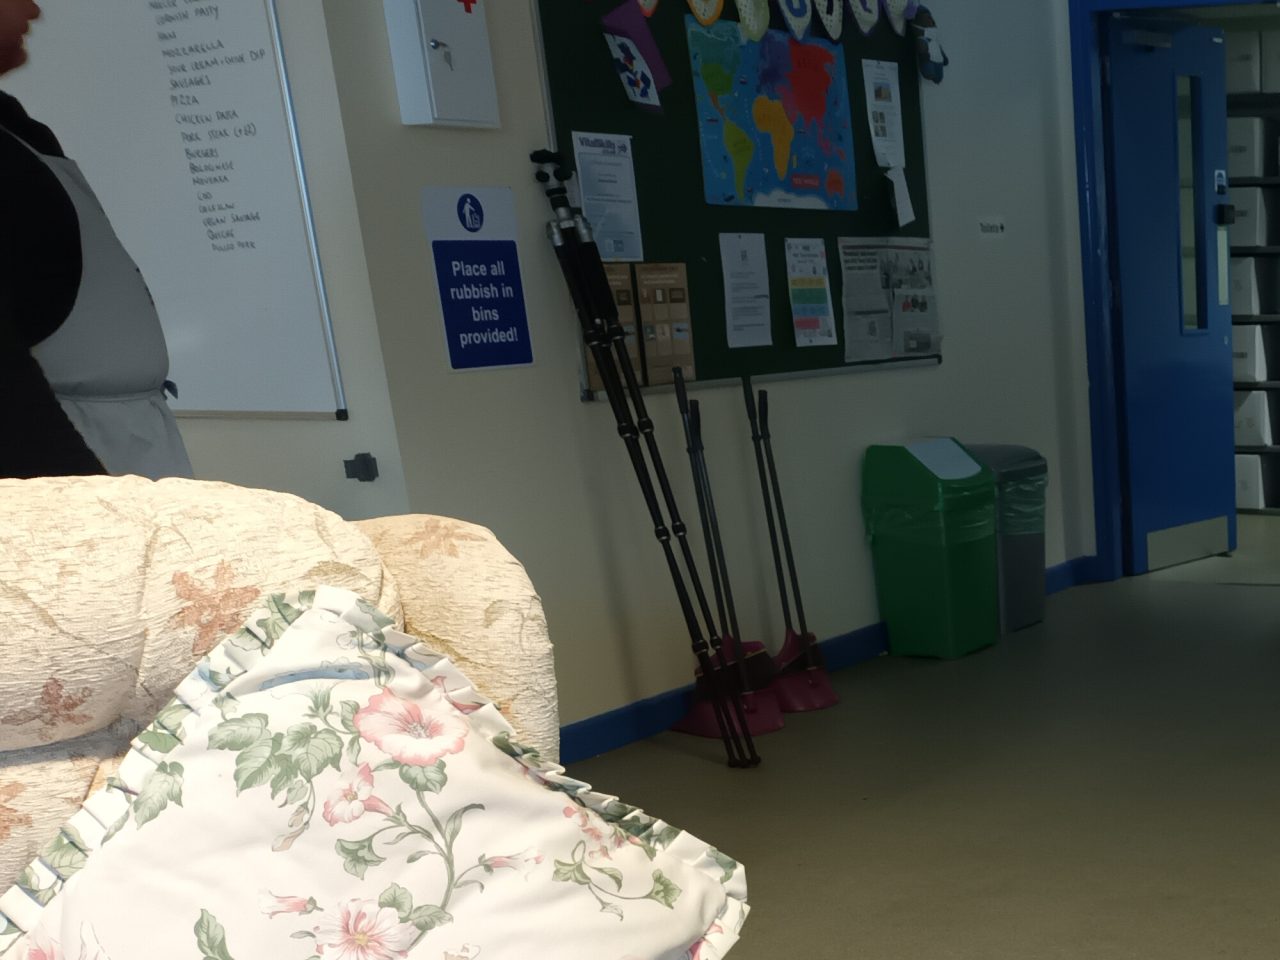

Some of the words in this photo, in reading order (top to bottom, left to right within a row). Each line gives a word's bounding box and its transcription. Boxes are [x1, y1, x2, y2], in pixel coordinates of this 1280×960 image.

[451, 260, 487, 276] Place
[490, 260, 505, 276] all
[450, 283, 499, 300] rubbish
[501, 282, 514, 298] in
[471, 306, 500, 322] bins
[459, 326, 519, 349] provided!
